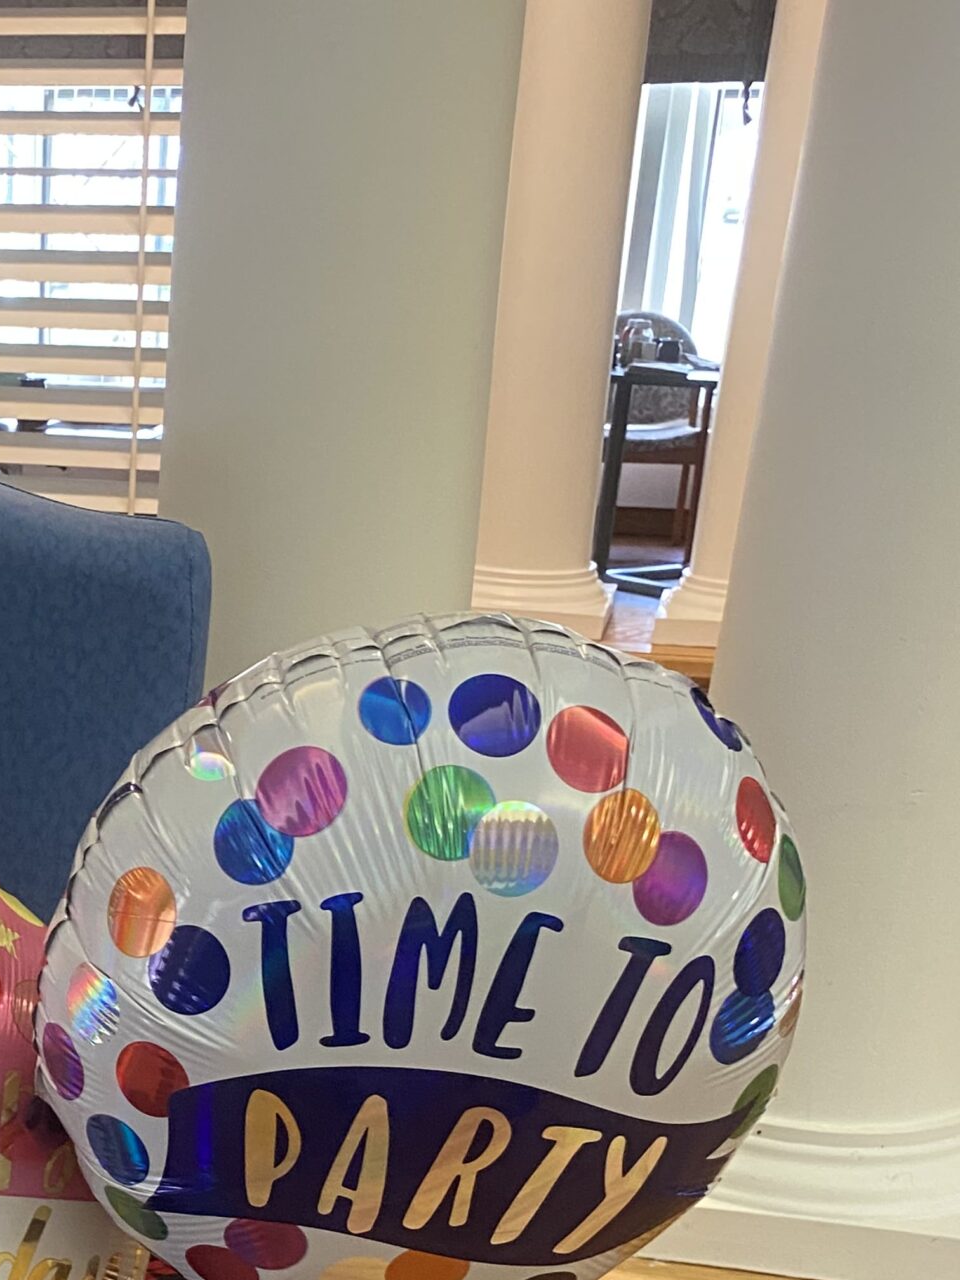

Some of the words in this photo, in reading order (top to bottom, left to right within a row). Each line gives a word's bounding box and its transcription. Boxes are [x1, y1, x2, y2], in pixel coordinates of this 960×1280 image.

[243, 891, 564, 1060] TIME
[574, 936, 716, 1096] TO
[244, 1088, 668, 1254] PARTY
